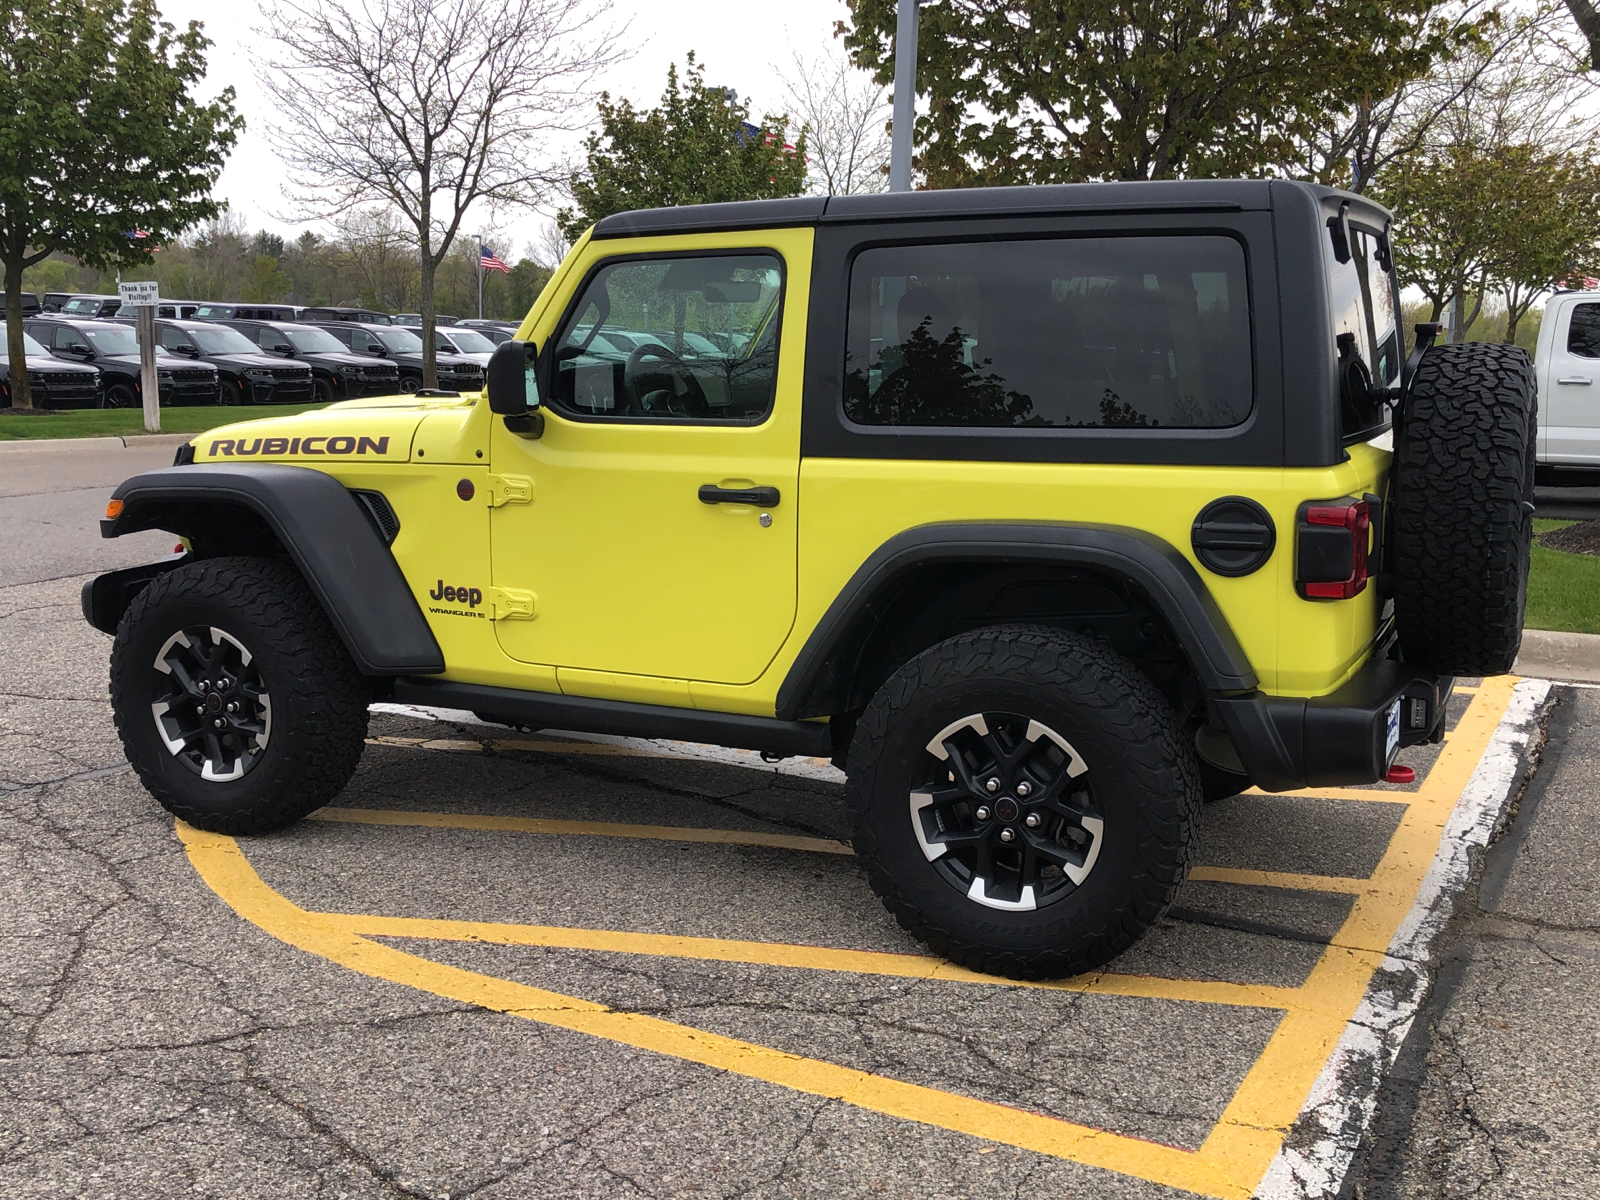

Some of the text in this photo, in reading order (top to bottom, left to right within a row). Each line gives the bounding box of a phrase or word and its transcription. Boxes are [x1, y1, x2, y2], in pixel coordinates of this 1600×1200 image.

[208, 436, 390, 456] RUBICON
[429, 579, 483, 609] Jeep
[428, 606, 476, 618] WRANGLER
